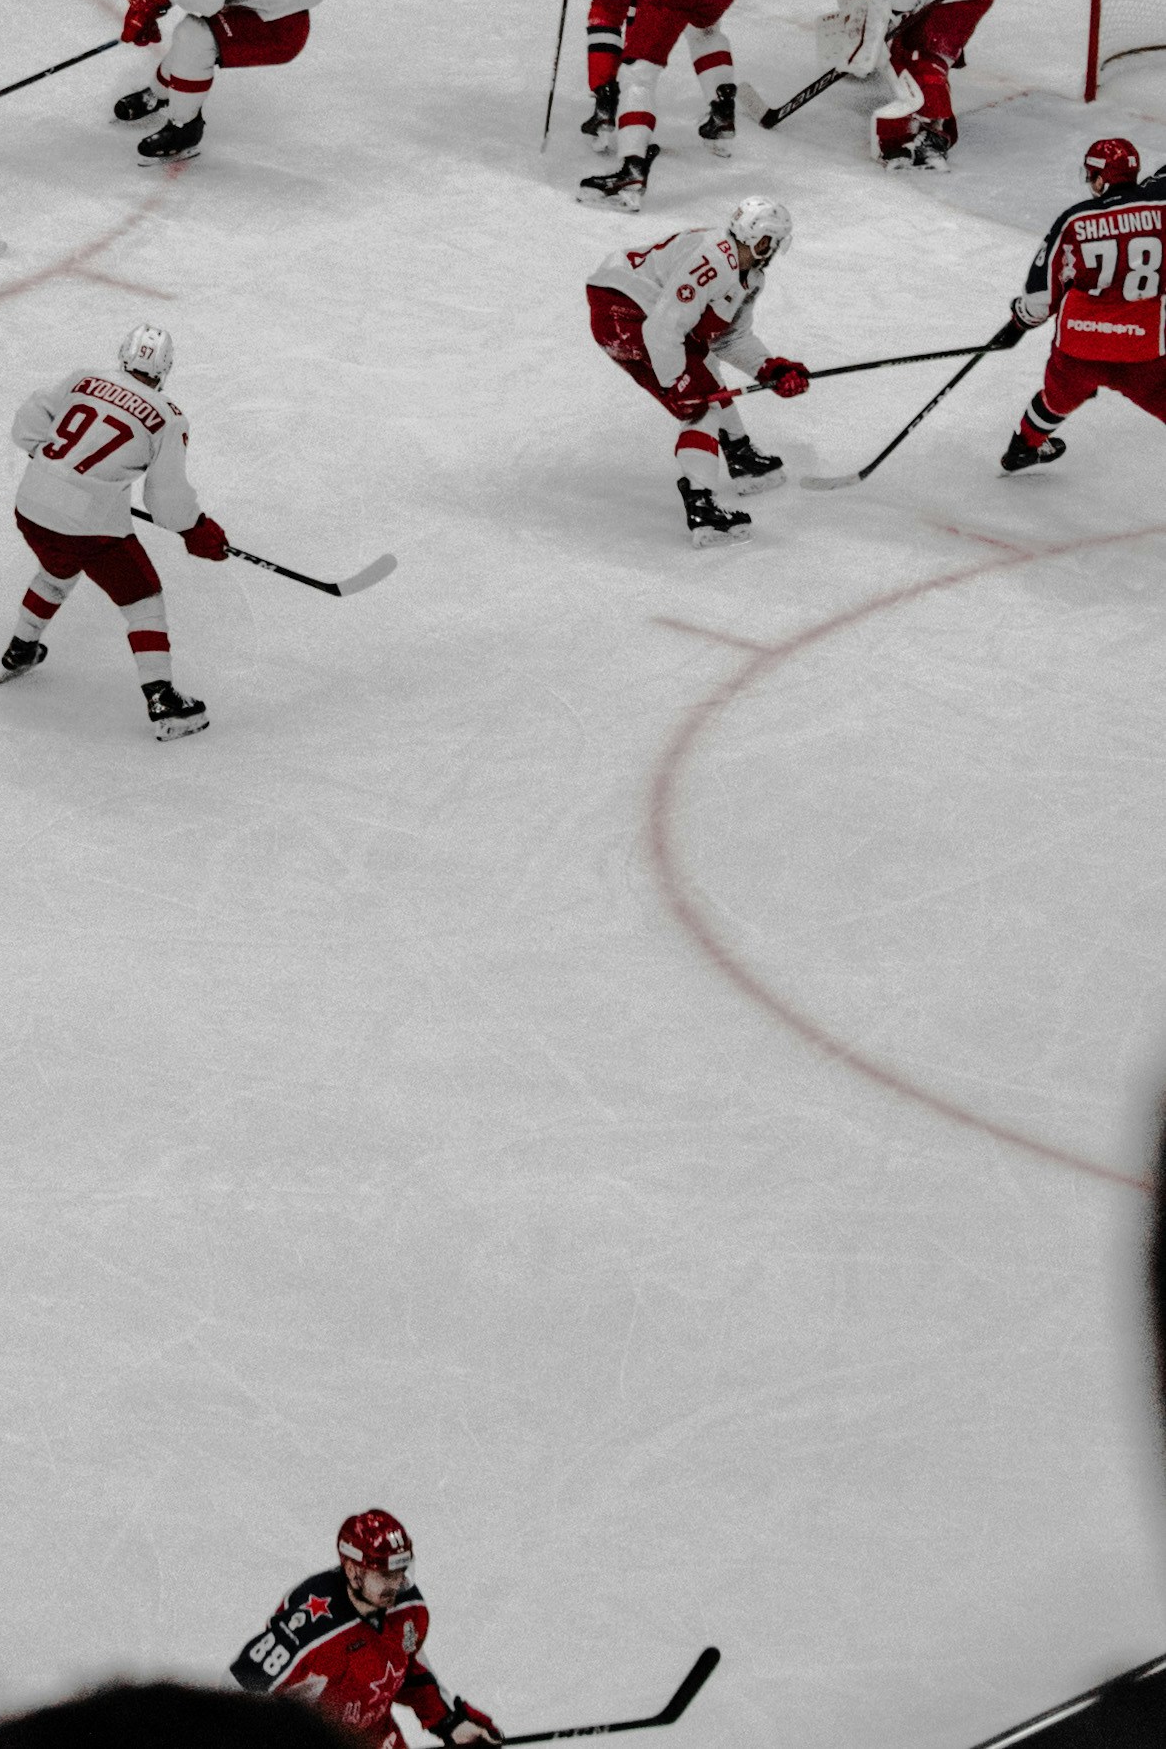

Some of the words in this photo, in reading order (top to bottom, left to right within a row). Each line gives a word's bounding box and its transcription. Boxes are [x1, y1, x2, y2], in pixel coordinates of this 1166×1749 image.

[1074, 210, 1162, 241] SHALUNOV
[689, 255, 717, 287] 78
[1081, 236, 1162, 302] 78
[139, 345, 154, 360] 97
[75, 377, 162, 431] FYODOROV
[42, 404, 134, 475] 97
[249, 1631, 290, 1677] 88
